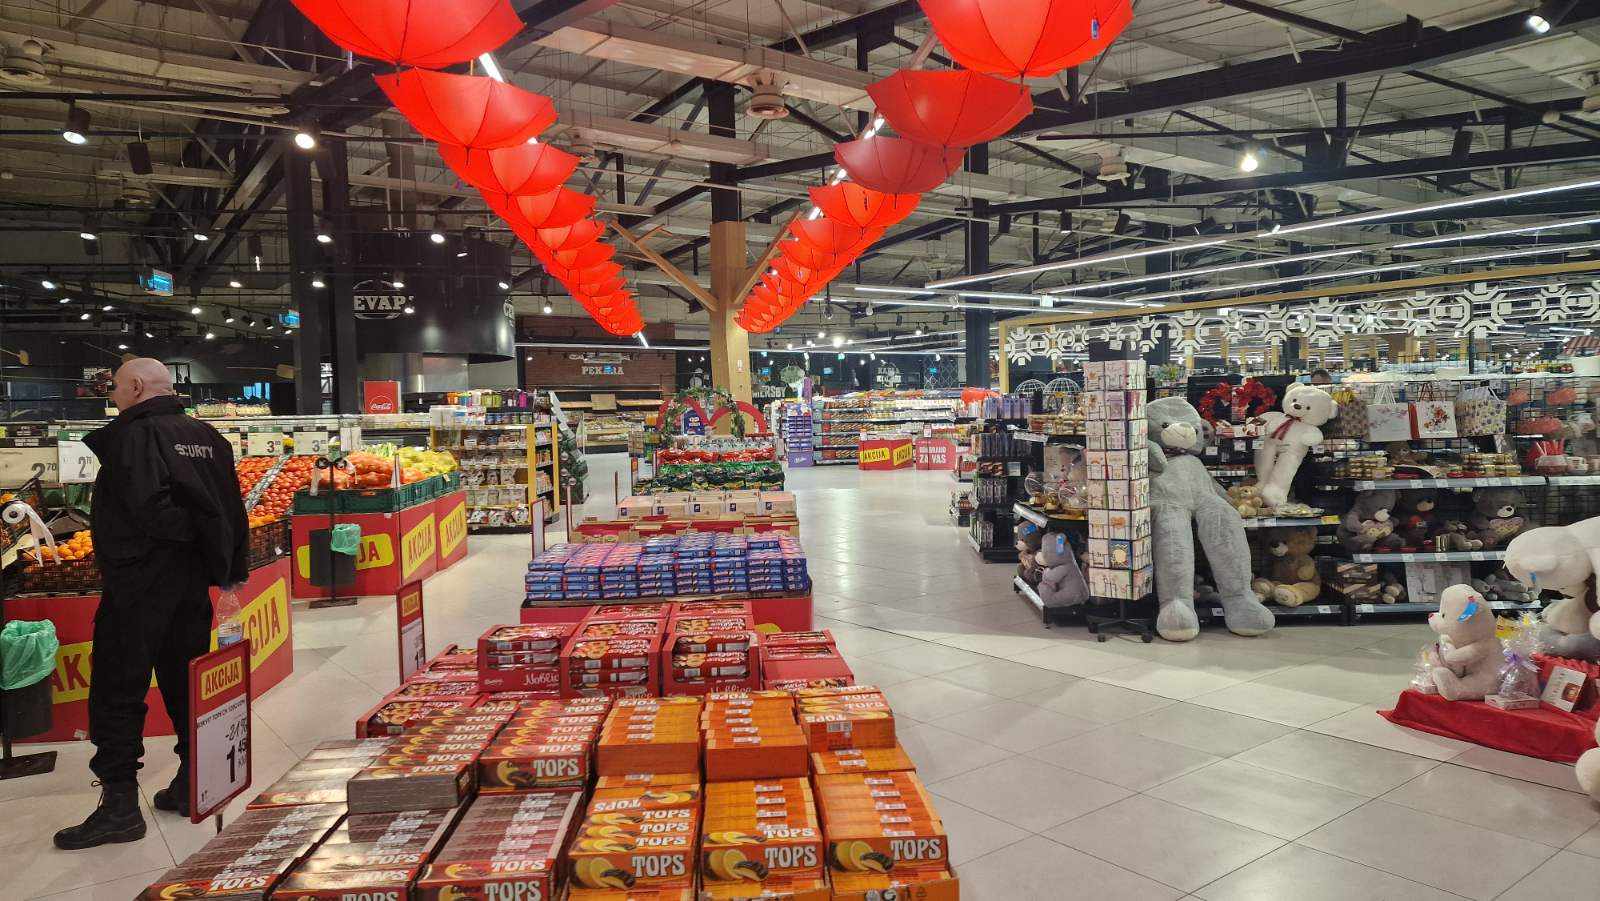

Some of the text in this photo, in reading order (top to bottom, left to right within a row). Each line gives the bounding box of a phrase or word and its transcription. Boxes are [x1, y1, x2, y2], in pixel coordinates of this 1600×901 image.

[354, 296, 414, 311] EVAP
[582, 366, 624, 375] PEKRA
[932, 454, 947, 464] VAS
[408, 525, 433, 565] AKCIJA
[243, 597, 281, 657] CIJA
[205, 661, 240, 696] AKCIJA
[563, 705, 605, 713] TOPS
[844, 701, 885, 709] TOPS
[557, 715, 600, 724] TOPS
[803, 713, 847, 723] TOPS
[453, 724, 496, 732] TOPS
[551, 725, 594, 733] TOPS
[546, 734, 589, 743] TOPS
[437, 743, 483, 751] TOPS
[538, 744, 583, 753] TOPS
[426, 753, 474, 762] TOPS
[227, 745, 235, 784] 1
[411, 764, 459, 773] TOPS
[532, 758, 579, 777] TOPS
[593, 799, 642, 812] TOPS
[642, 808, 691, 819] TOPS
[639, 822, 690, 834] TOPS
[762, 828, 816, 839] TOPS
[635, 836, 687, 847] TOPS
[890, 838, 942, 861] TOPS
[764, 845, 817, 869] TOPS
[491, 860, 546, 872] TOPS
[631, 854, 685, 878] TOPS
[210, 876, 268, 891] TOPS
[484, 880, 542, 901] TOPS
